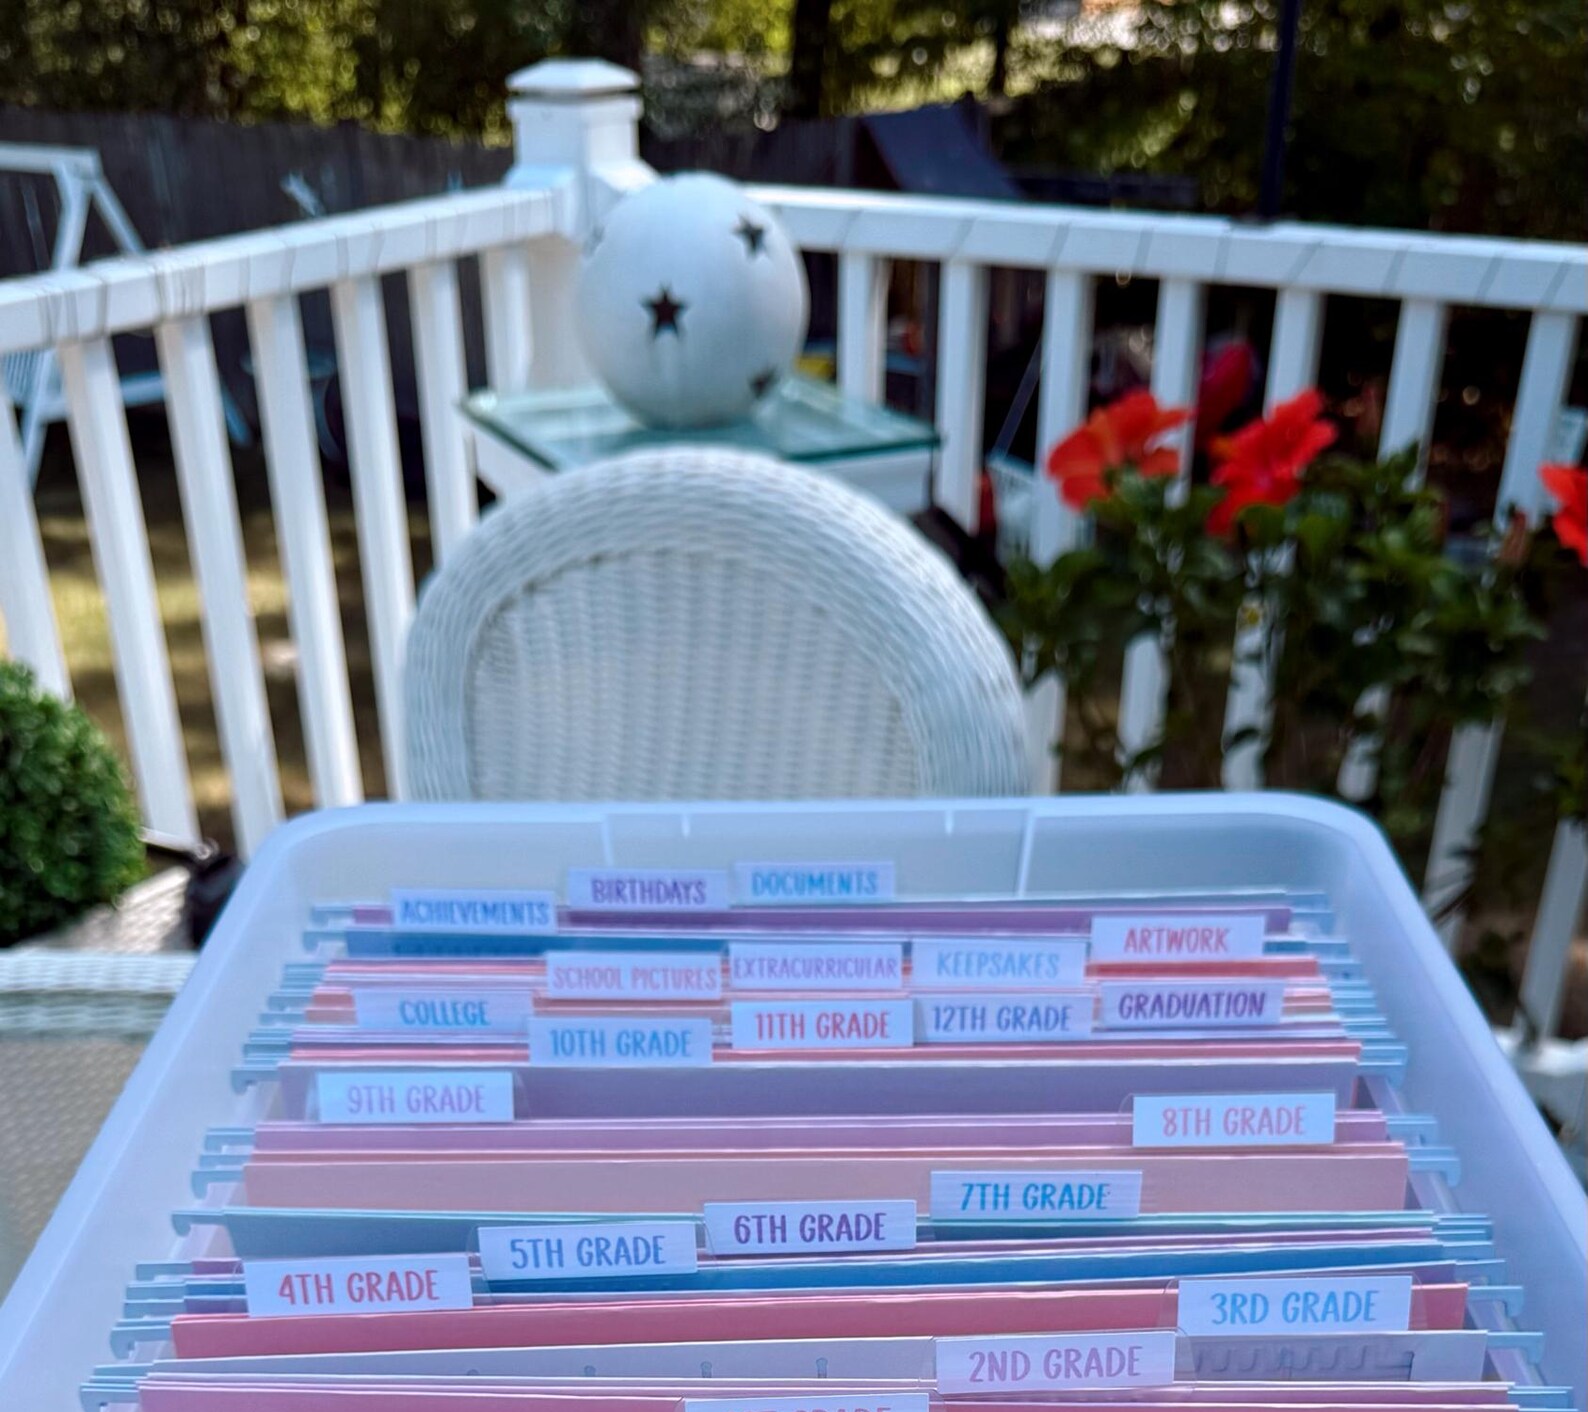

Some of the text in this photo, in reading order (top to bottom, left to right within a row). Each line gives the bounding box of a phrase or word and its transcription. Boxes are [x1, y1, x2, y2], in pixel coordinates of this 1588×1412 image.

[591, 879, 706, 904] BIRTHDAYS
[752, 872, 878, 896] DOCUMENTS
[402, 901, 549, 926] ACHIEVEMENTS
[1124, 927, 1229, 953] ARTWORK
[553, 966, 717, 990] SCHOOL PICTURES
[733, 955, 898, 979] EXTRACURRICULAR
[936, 952, 1059, 978] KEEPSAKES
[400, 1000, 491, 1026] COLLEGE
[933, 1005, 1071, 1032] 12TH GRADE
[1118, 991, 1266, 1020] GRADUATION
[755, 1012, 890, 1040] 11TH GRADE
[550, 1029, 692, 1057] 10TH GRADE
[347, 1085, 485, 1114] 9TH GRADE
[1162, 1105, 1307, 1137] 8TH GRADE
[960, 1183, 1111, 1211] 7TH GRADE
[734, 1211, 887, 1244] 6TH GRADE
[511, 1235, 667, 1269] 5TH GRADE
[278, 1269, 441, 1305] 4TH GRADE
[1211, 1289, 1380, 1326] 3RD GRADE
[968, 1345, 1142, 1383] 2ND GRADE
